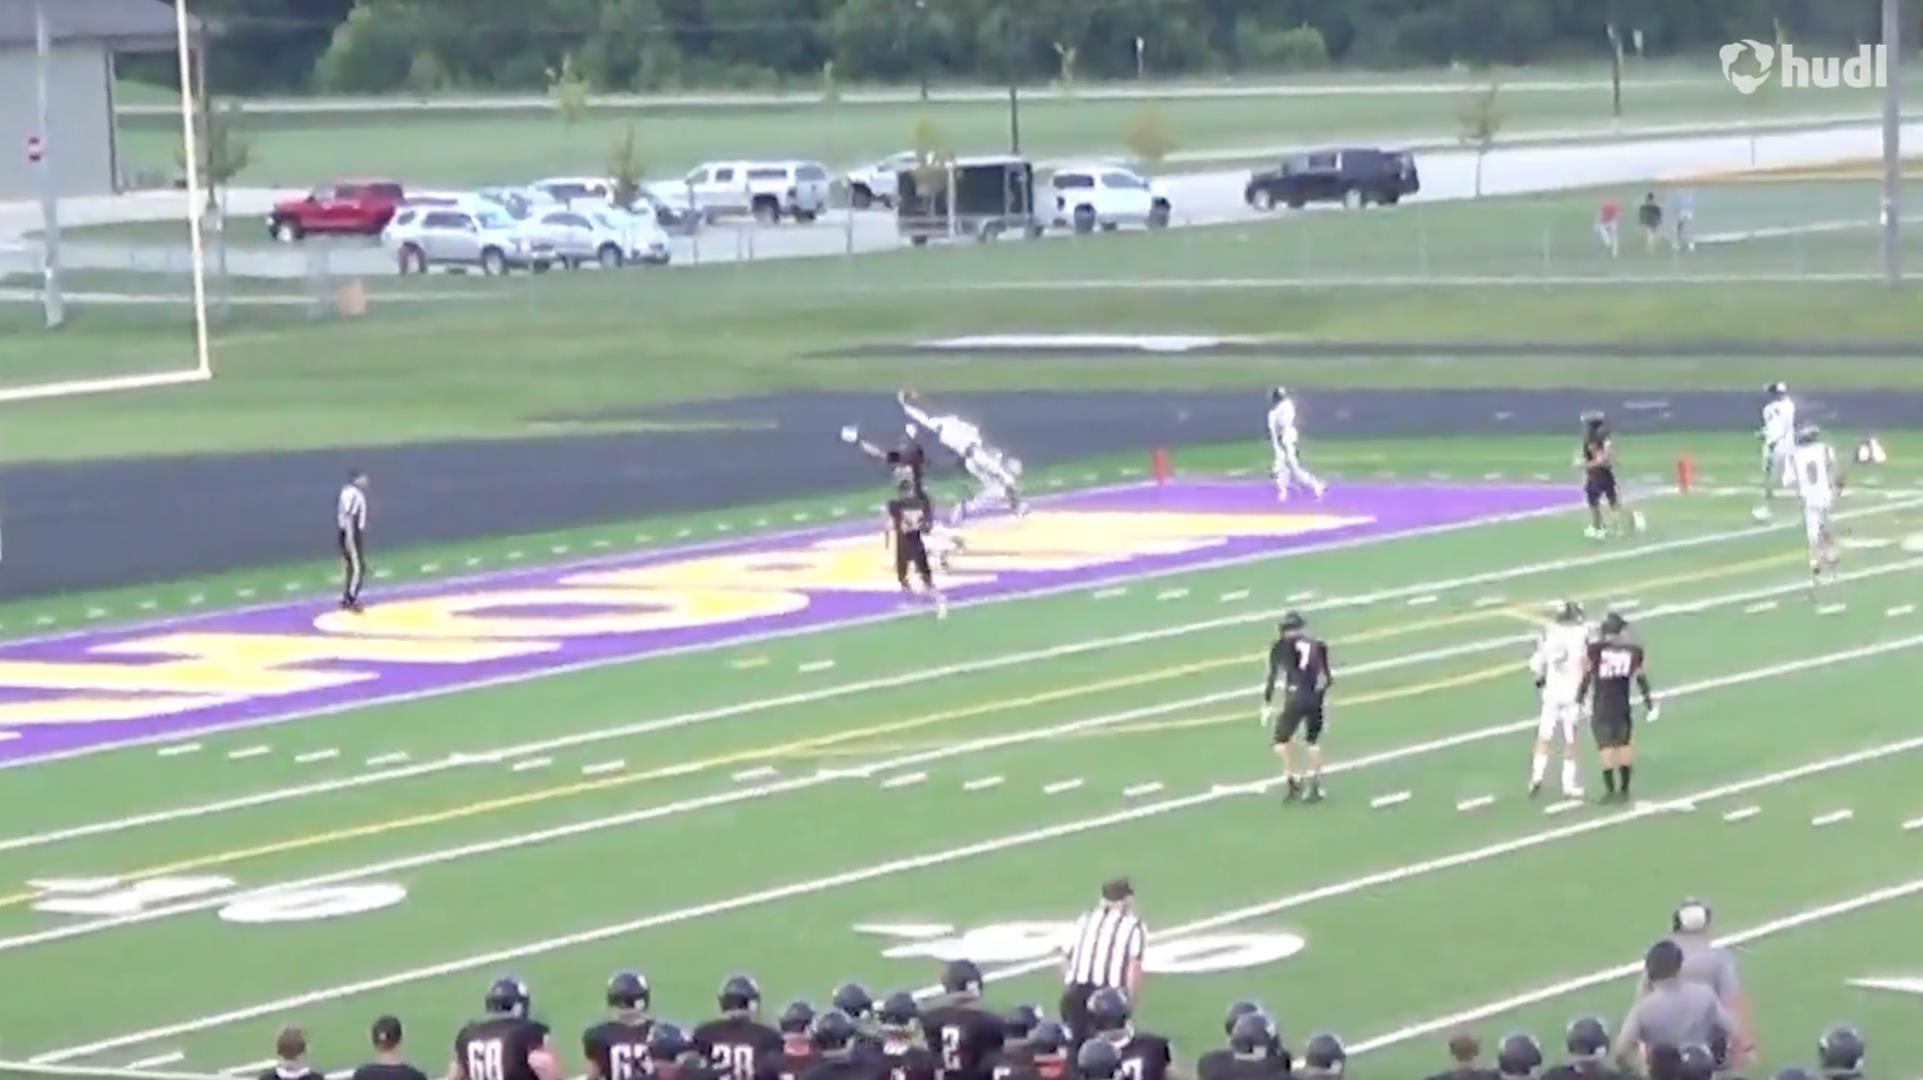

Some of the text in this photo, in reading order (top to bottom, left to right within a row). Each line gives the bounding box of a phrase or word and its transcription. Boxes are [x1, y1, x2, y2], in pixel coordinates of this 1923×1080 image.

[1295, 640, 1310, 670] 7
[467, 1039, 504, 1080] 68
[941, 1026, 962, 1070] 2
